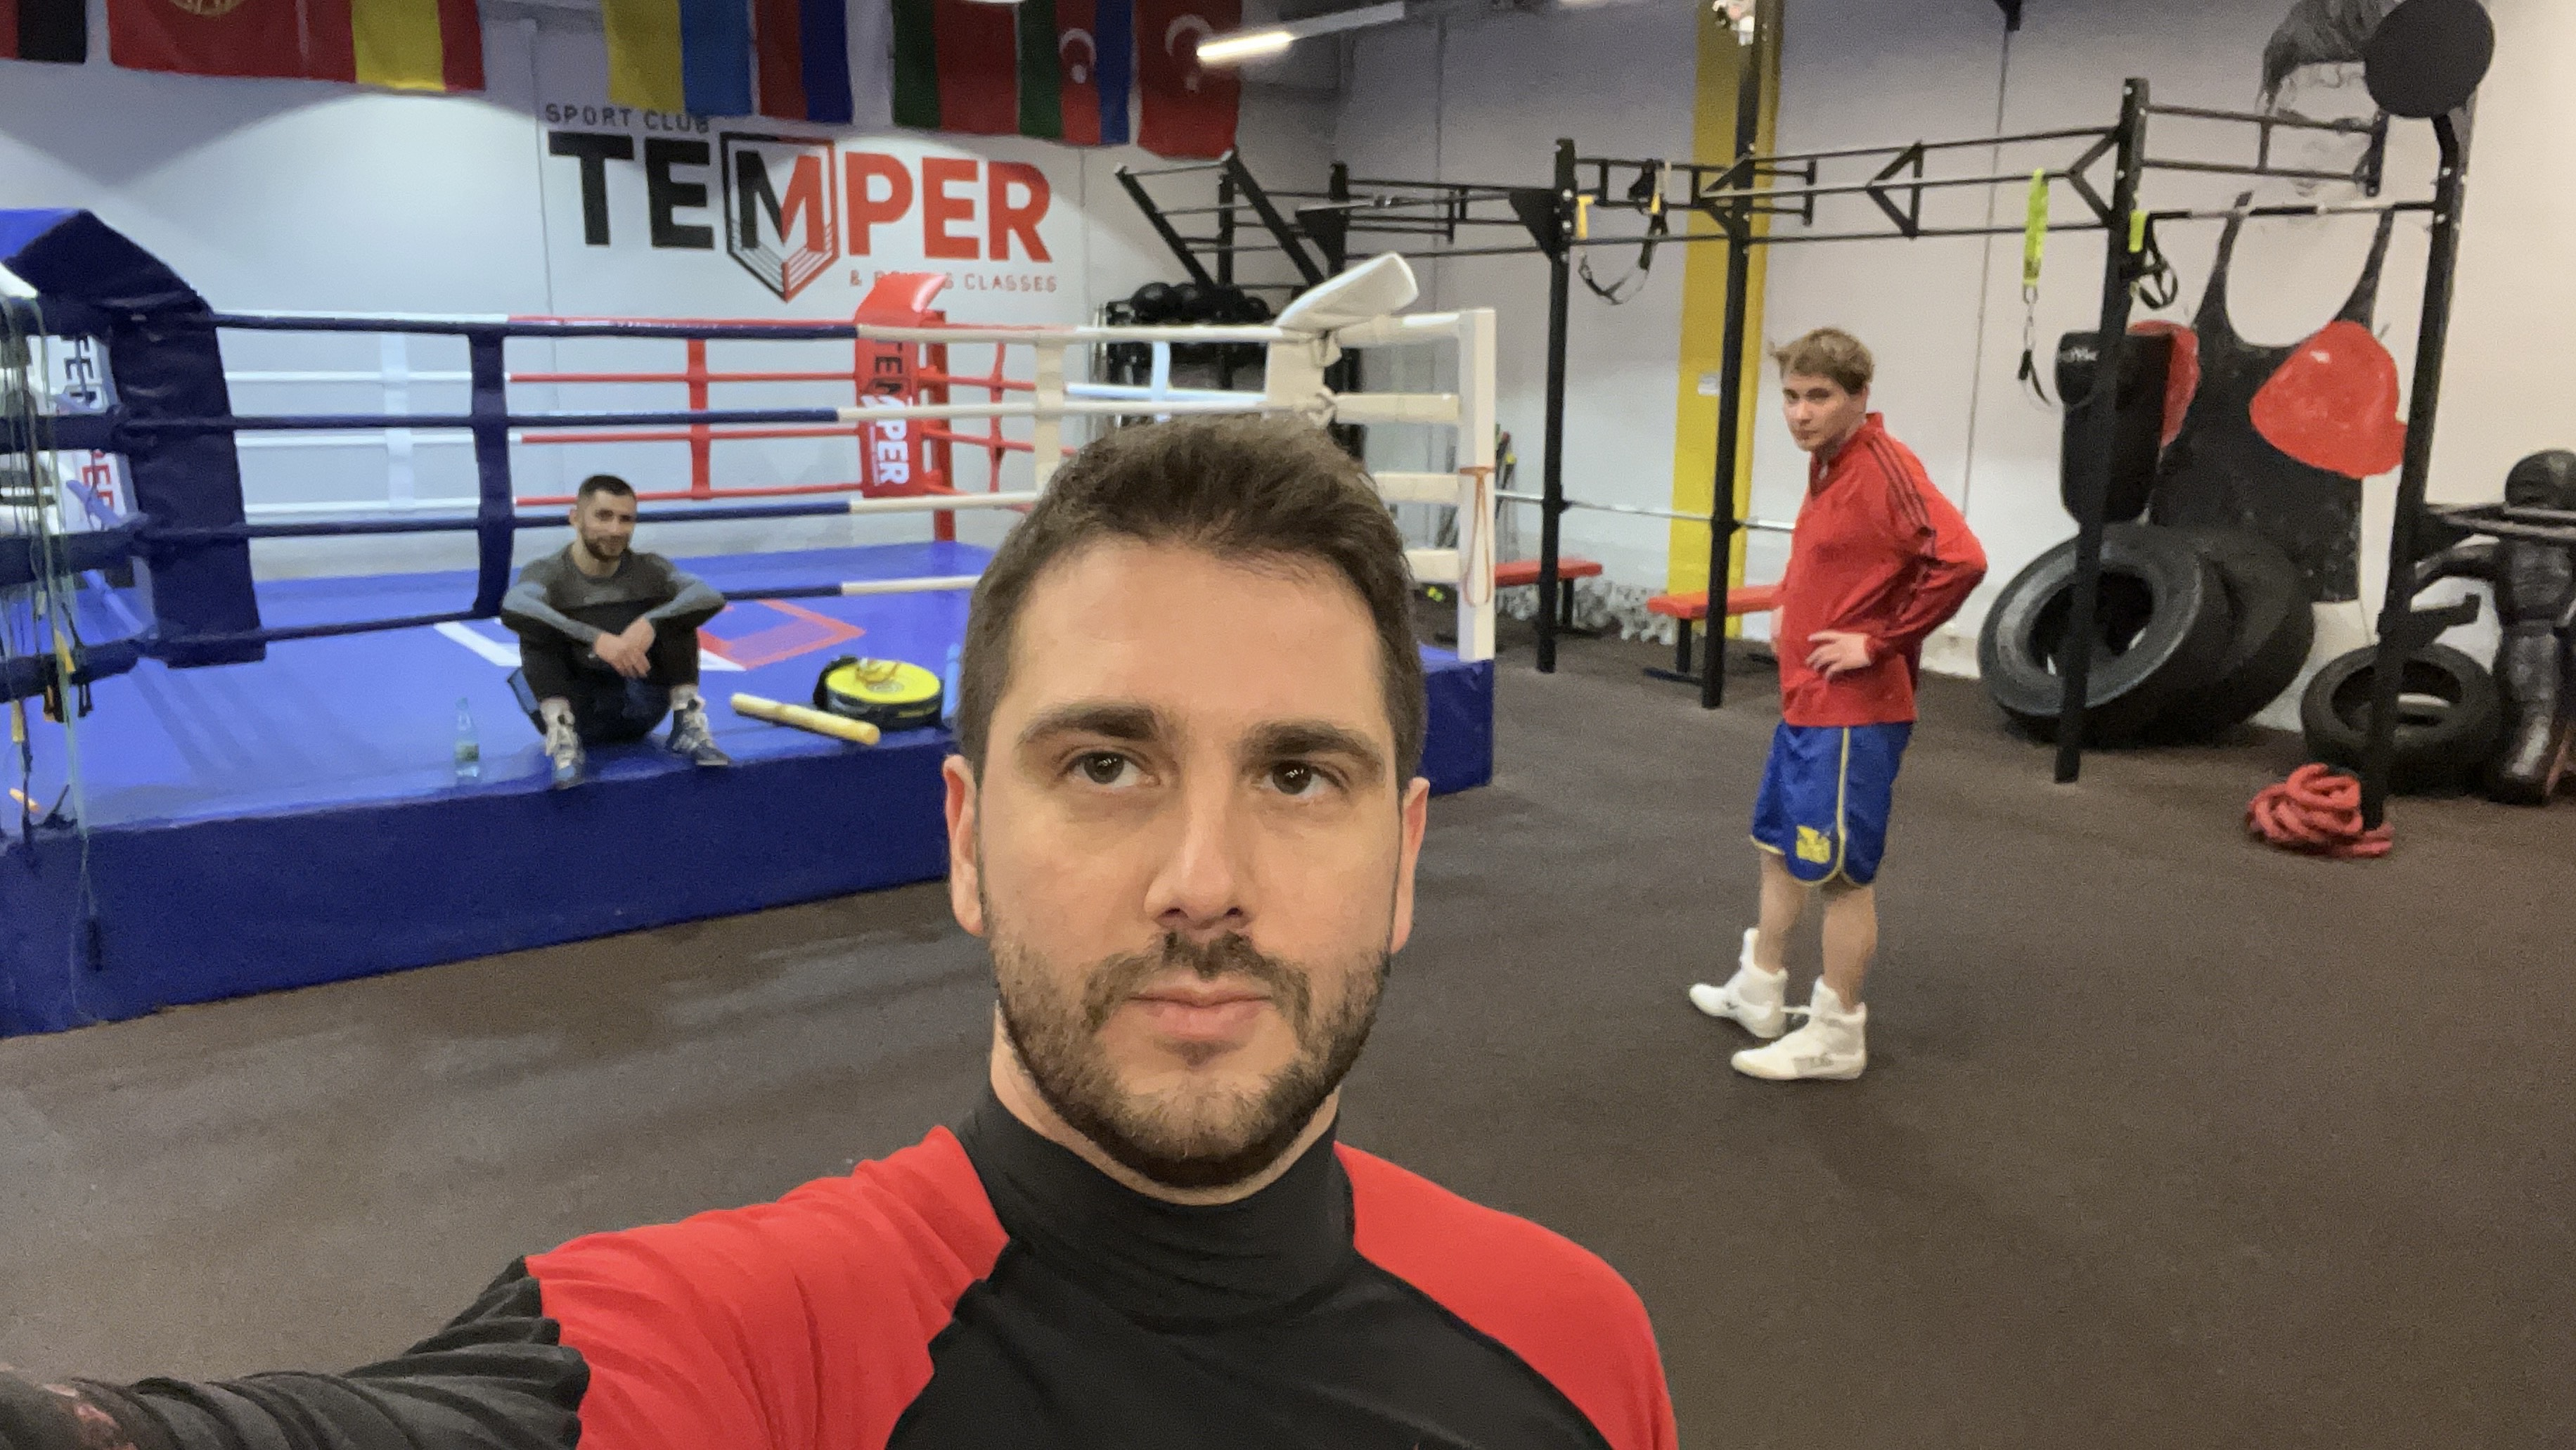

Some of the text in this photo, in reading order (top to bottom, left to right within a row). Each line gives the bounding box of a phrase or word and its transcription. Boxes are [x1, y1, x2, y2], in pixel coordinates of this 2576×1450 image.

[545, 103, 710, 135] SPORT CLUB
[548, 131, 1053, 263] TEMPER
[849, 269, 862, 288] &
[963, 272, 1058, 293] CLASSES
